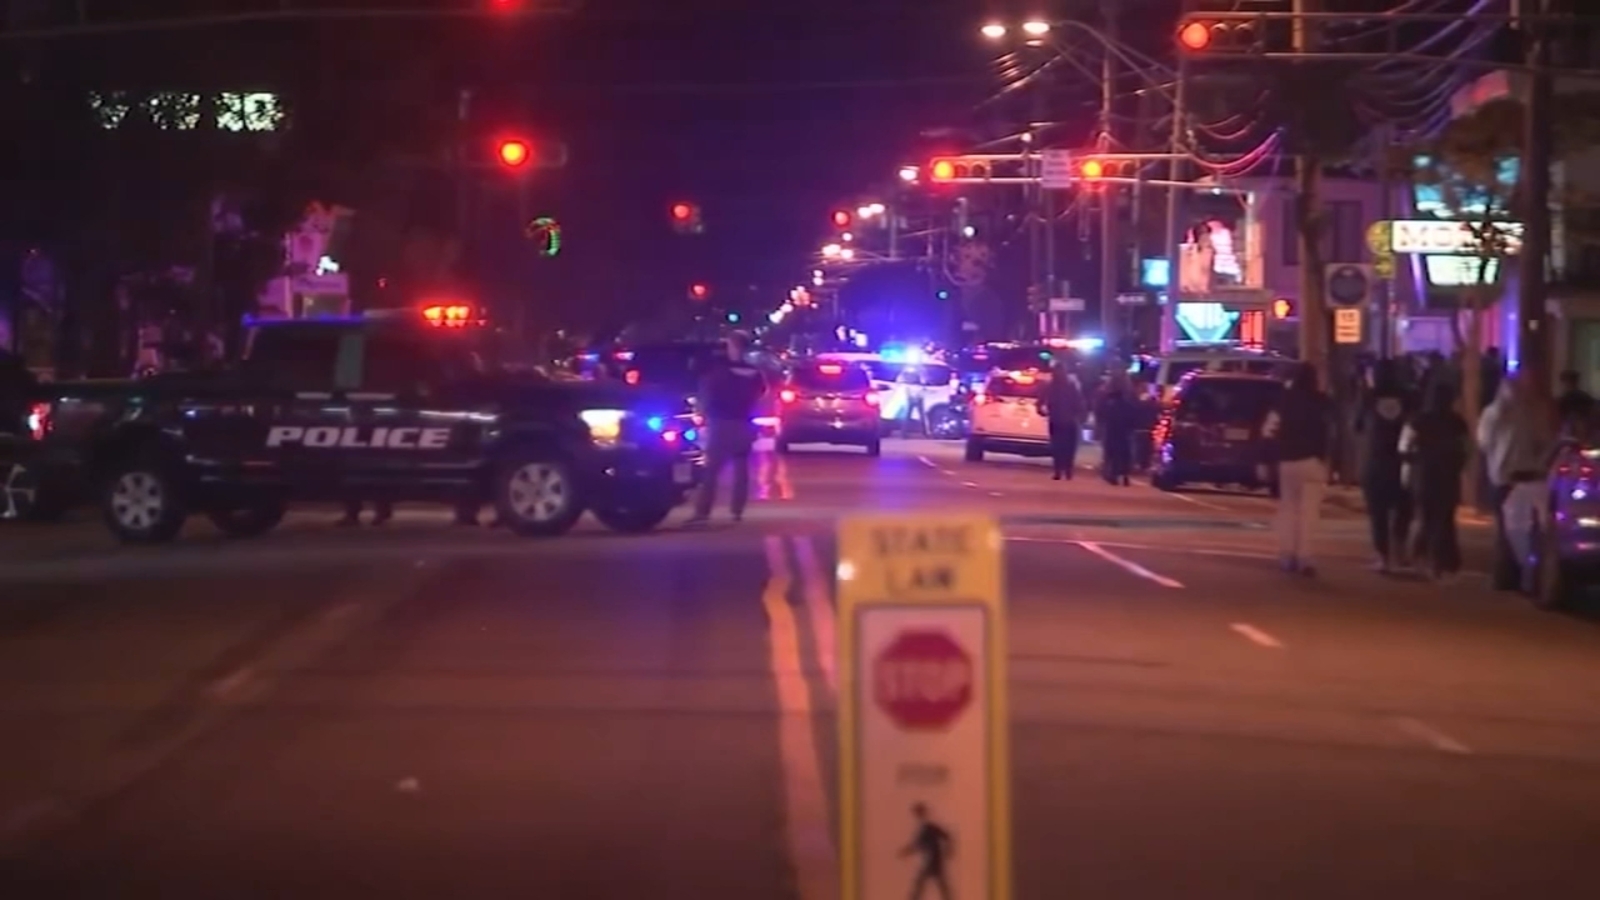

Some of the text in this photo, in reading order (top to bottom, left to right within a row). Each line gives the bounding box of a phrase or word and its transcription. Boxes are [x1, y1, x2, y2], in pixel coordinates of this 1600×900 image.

[266, 426, 450, 448] POLICE
[870, 525, 974, 557] STATE
[885, 566, 956, 595] LAW
[876, 661, 969, 702] STOP
